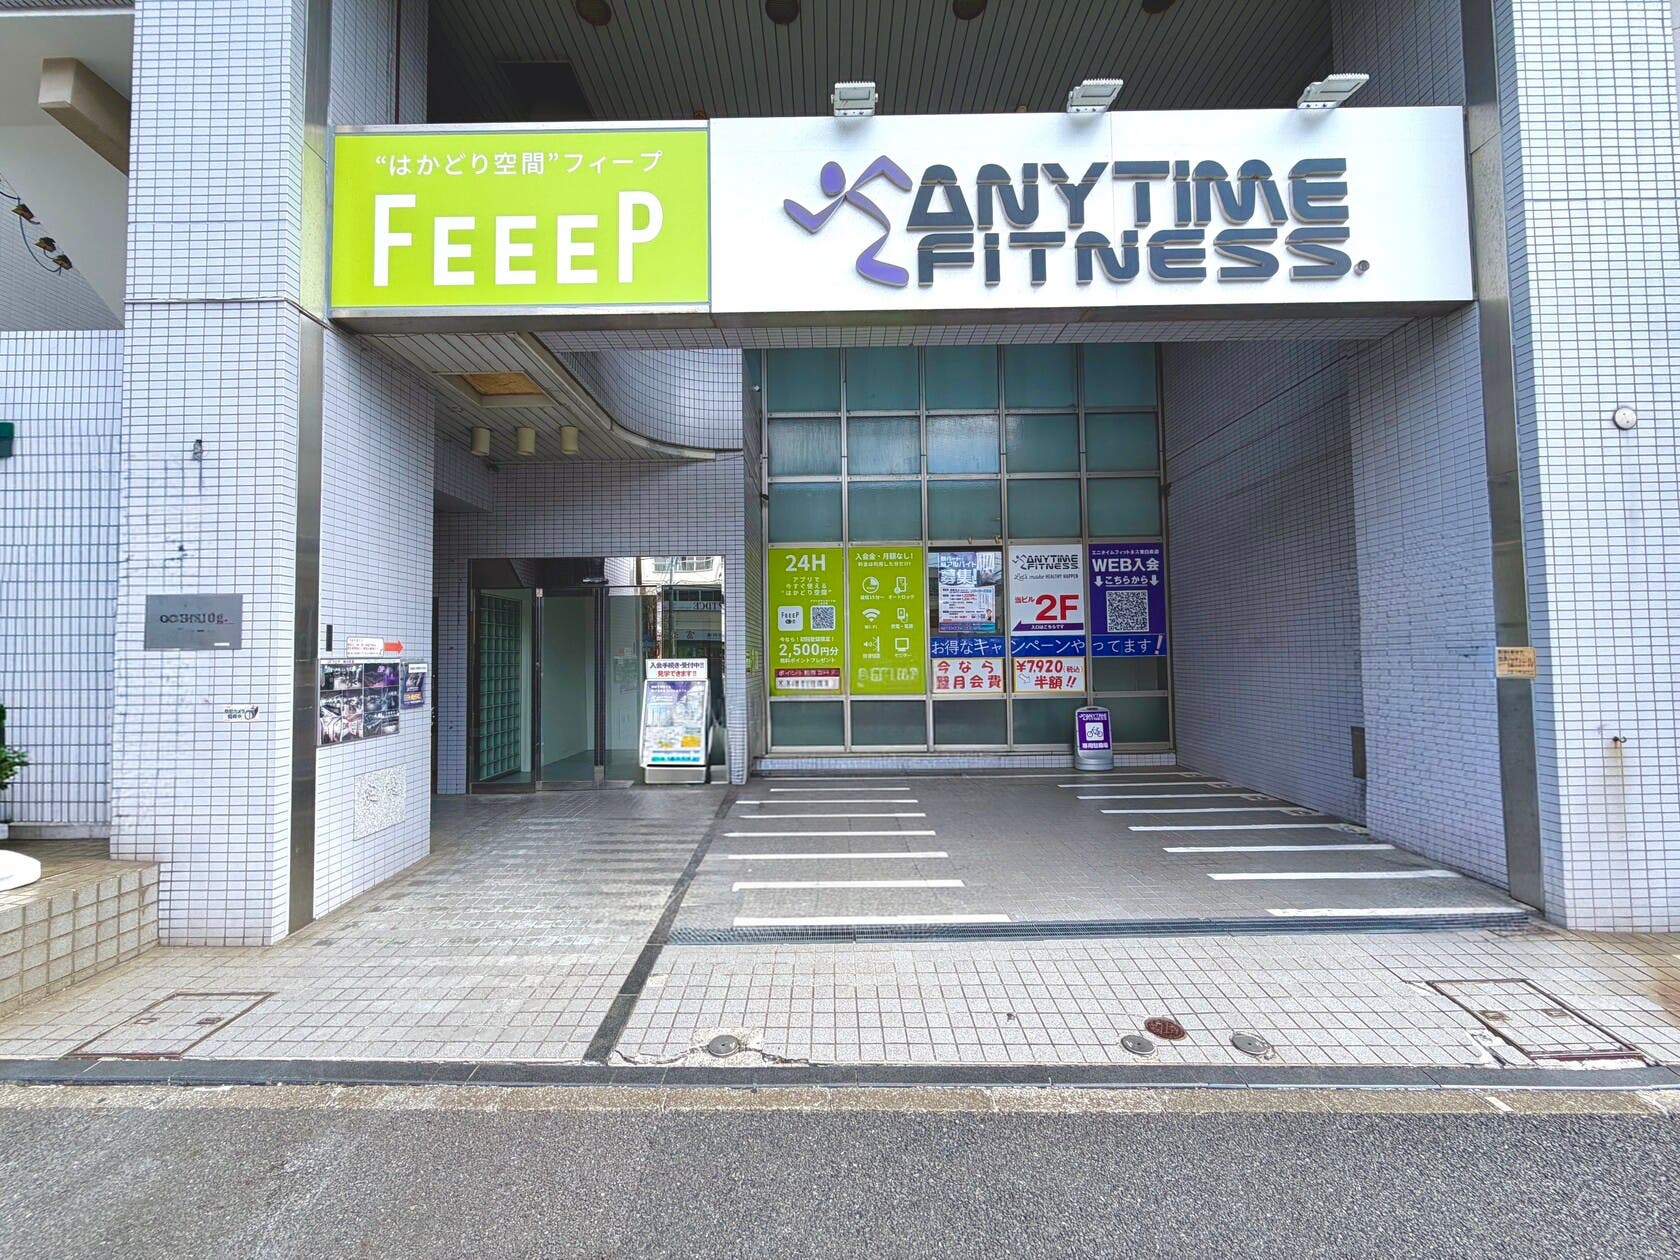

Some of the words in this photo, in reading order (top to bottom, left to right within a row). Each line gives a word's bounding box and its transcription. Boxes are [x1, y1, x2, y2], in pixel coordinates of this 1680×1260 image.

[907, 157, 1351, 230] ANYTIME
[373, 191, 663, 287] FEEEP
[917, 227, 1354, 287] FITNESS
[785, 553, 826, 572] 24H
[1026, 555, 1079, 563] ANYTIME
[1027, 562, 1079, 570] FITNESS
[1092, 558, 1160, 572] WEB入会
[940, 569, 977, 584] 募集!
[1105, 575, 1148, 585] こちらから
[1015, 596, 1035, 604] 当ビル
[1035, 594, 1079, 621] 2F
[779, 643, 839, 657] 2,500円分
[937, 661, 995, 674] 今なら
[936, 674, 1002, 689] 翌月会費
[1034, 675, 1077, 689] 半額!!
